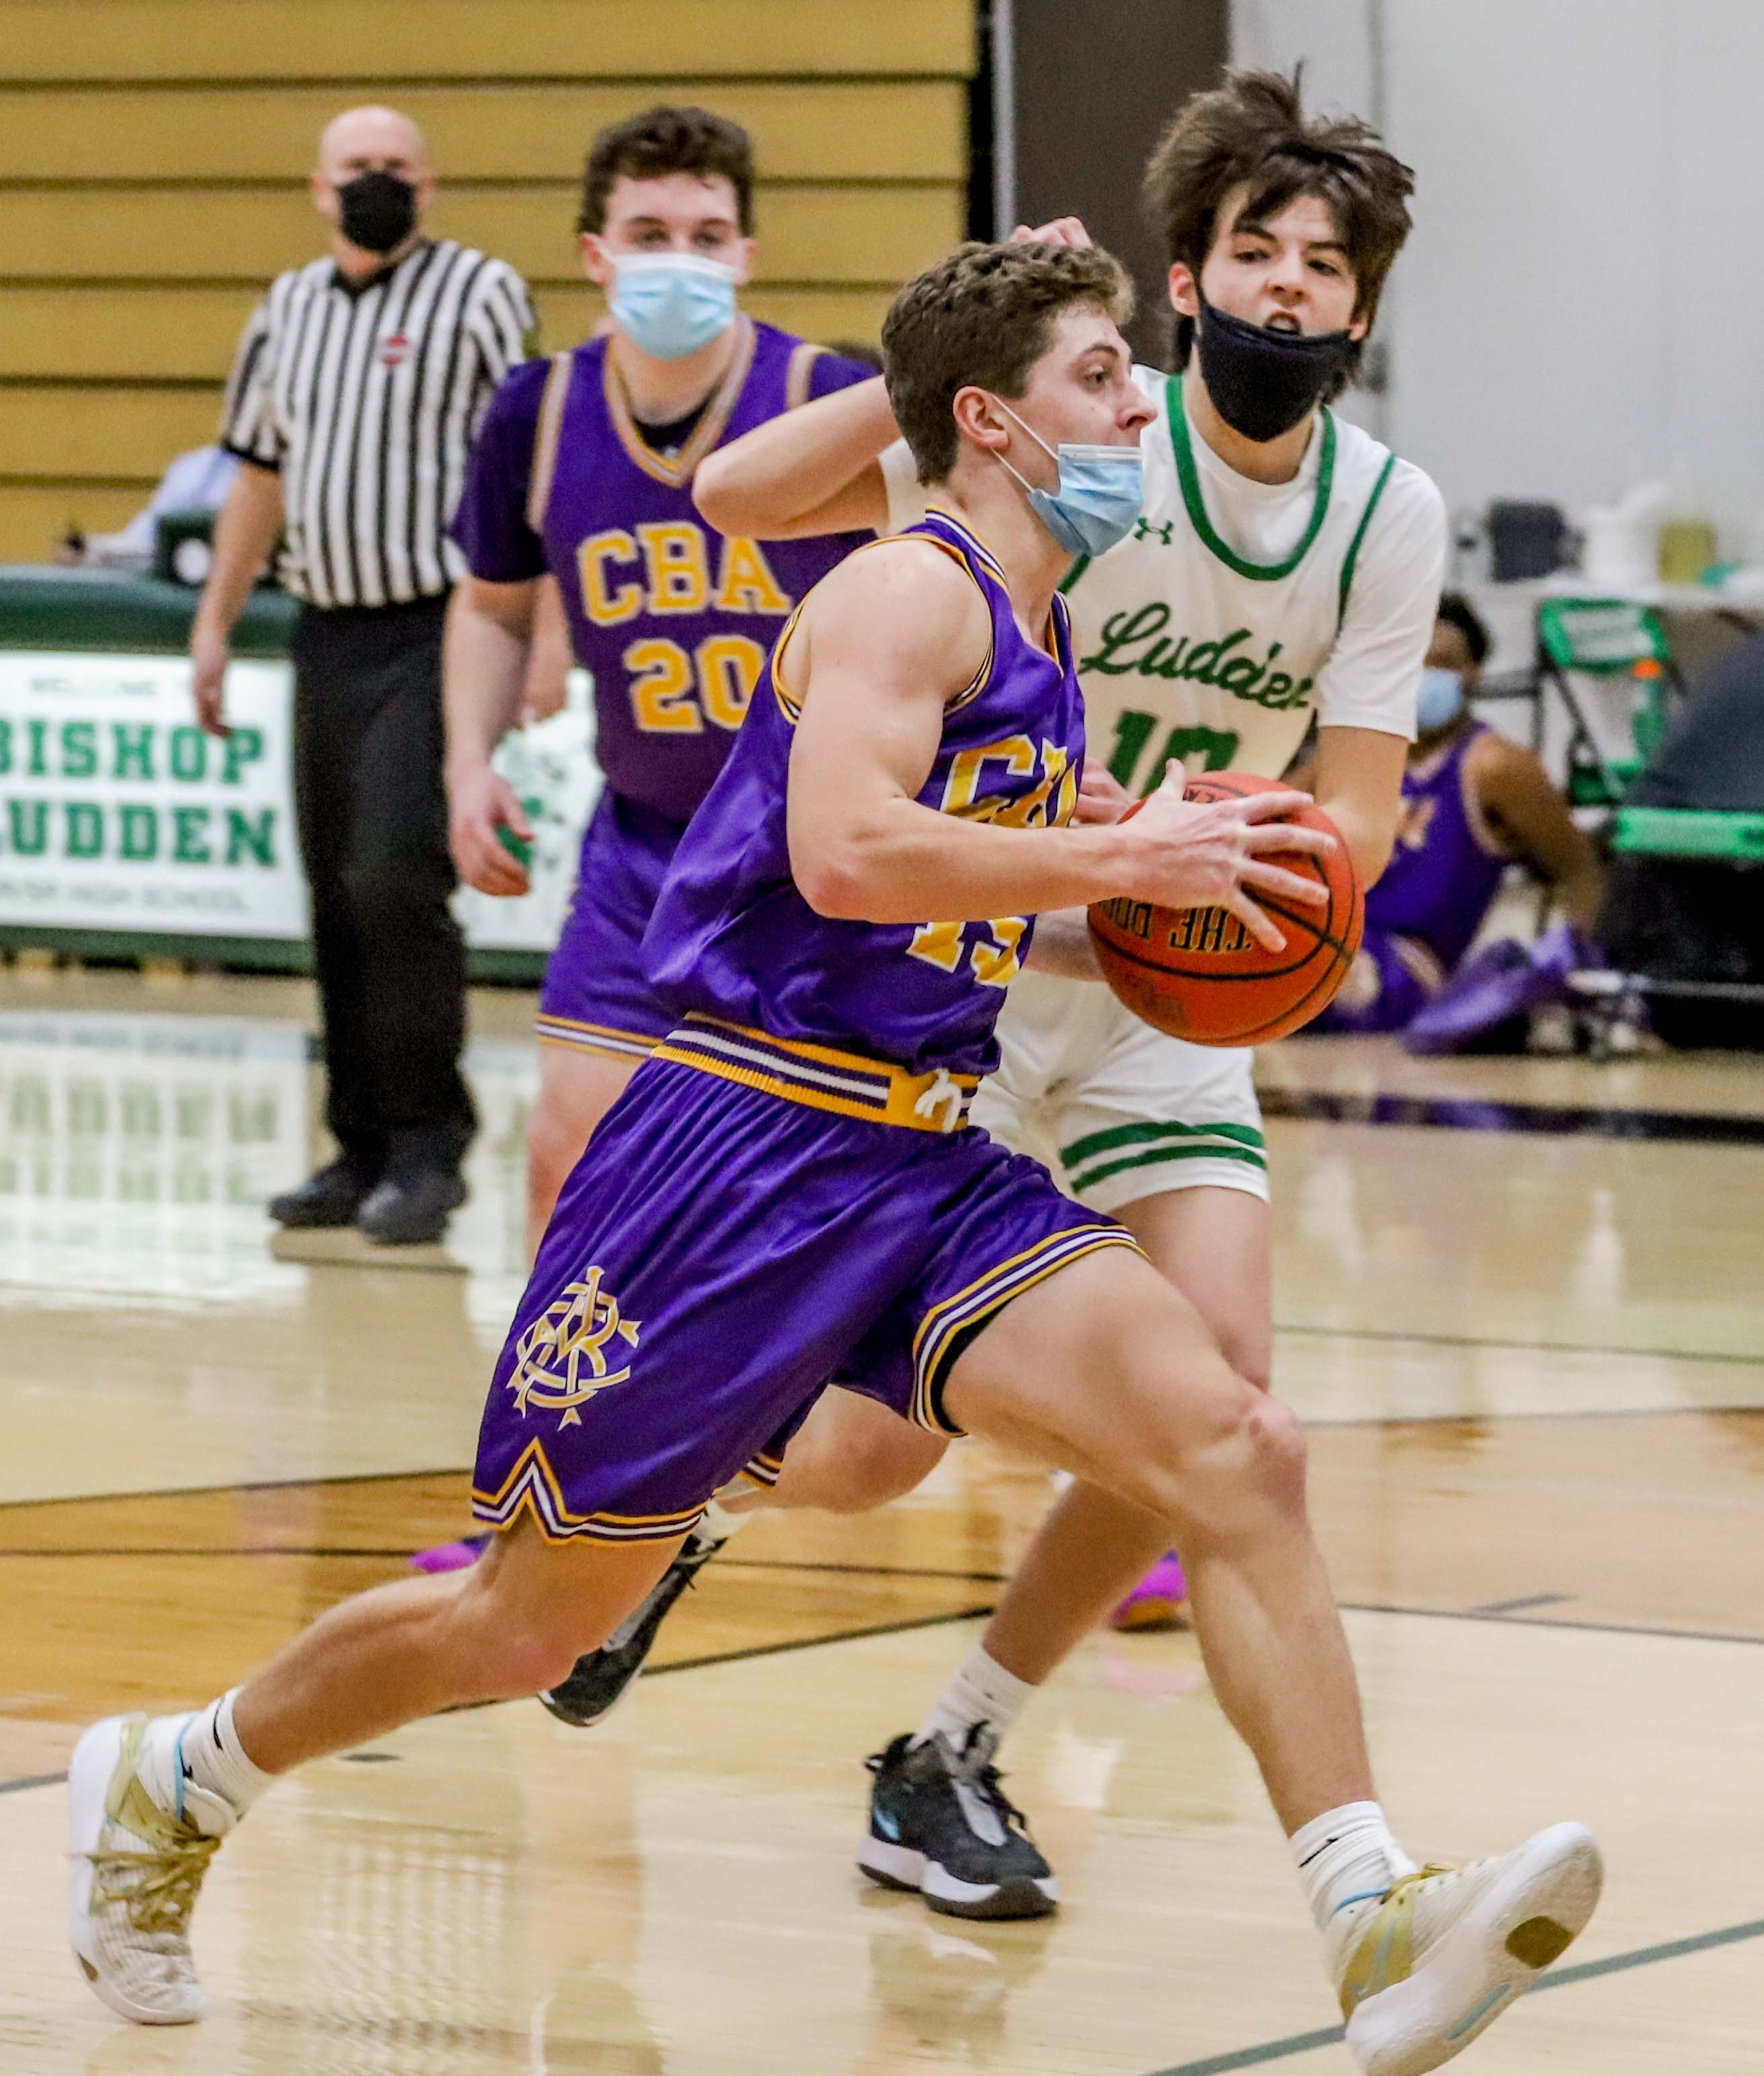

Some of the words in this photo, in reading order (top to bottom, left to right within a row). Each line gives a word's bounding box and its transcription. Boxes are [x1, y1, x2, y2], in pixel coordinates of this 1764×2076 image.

[576, 520, 793, 627] CBA
[623, 635, 765, 733] 20
[0, 801, 276, 866] UDDEN
